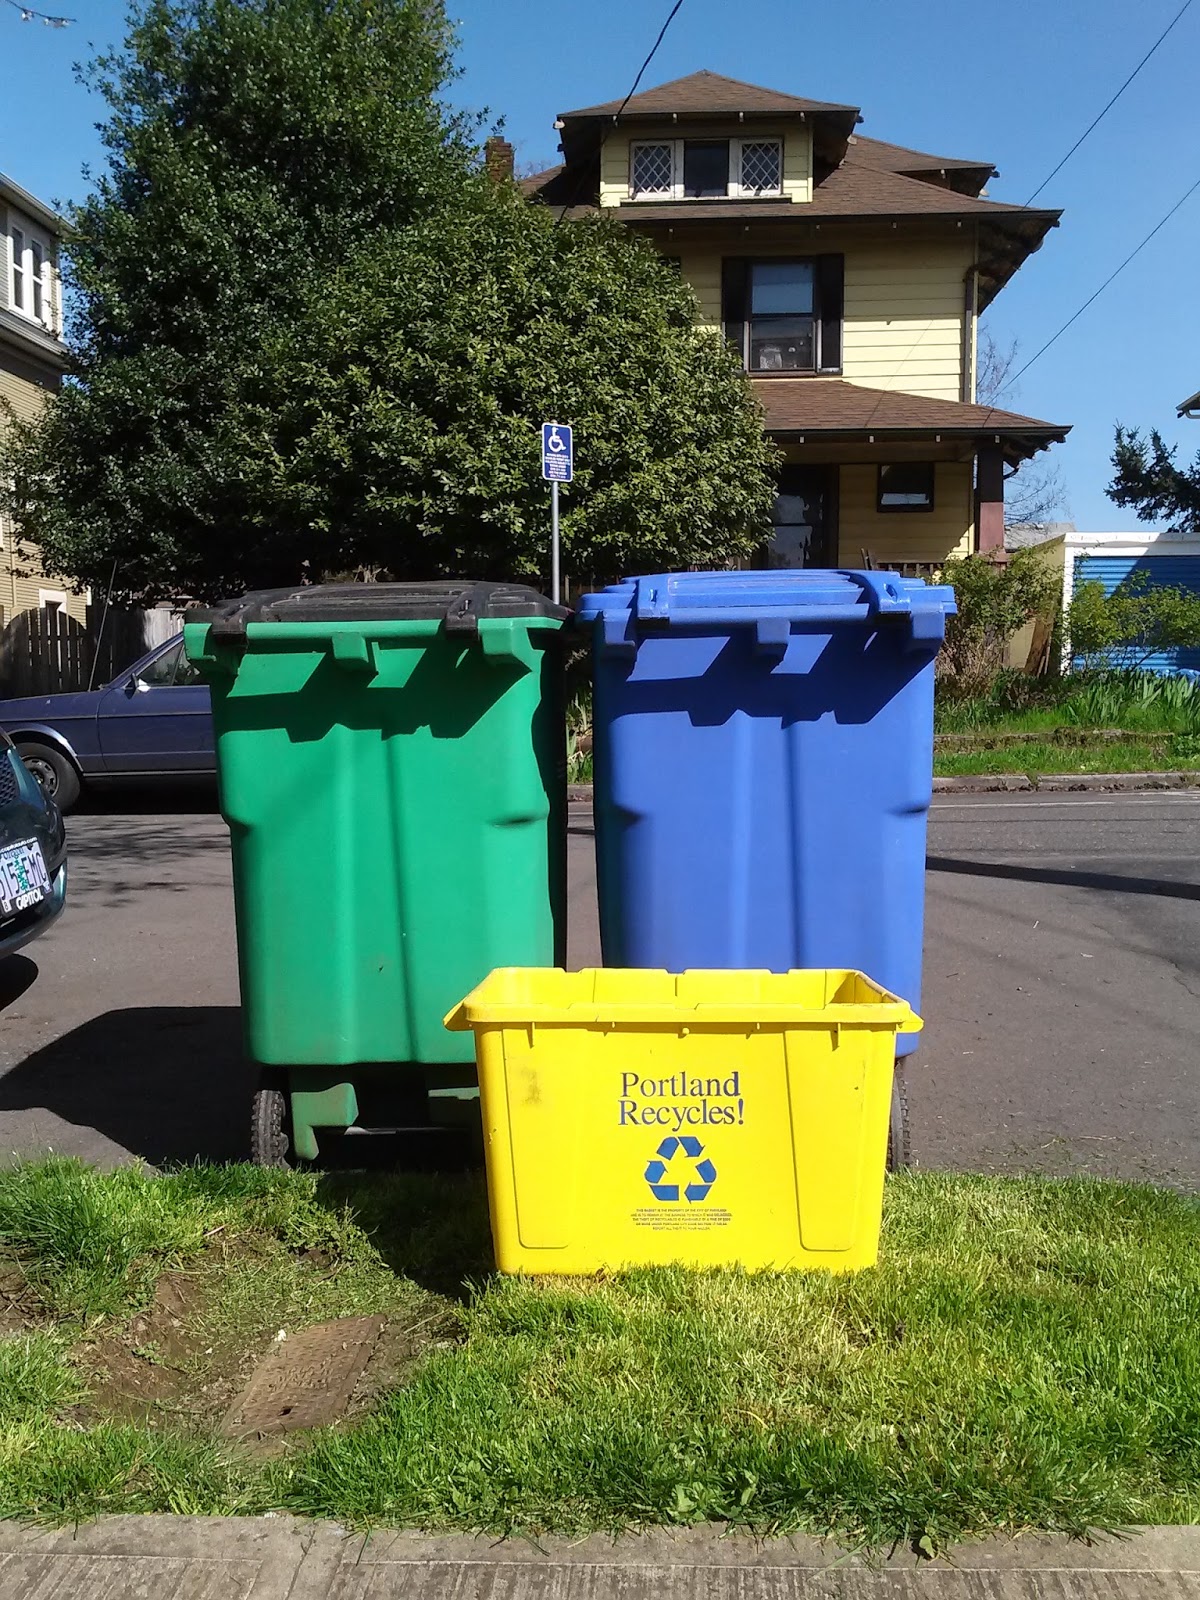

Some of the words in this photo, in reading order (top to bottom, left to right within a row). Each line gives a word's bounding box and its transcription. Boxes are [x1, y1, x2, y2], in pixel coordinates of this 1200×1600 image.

[16, 887, 43, 910] CAPITOL
[620, 1071, 741, 1097] Portland
[618, 1098, 744, 1132] Recycles!
